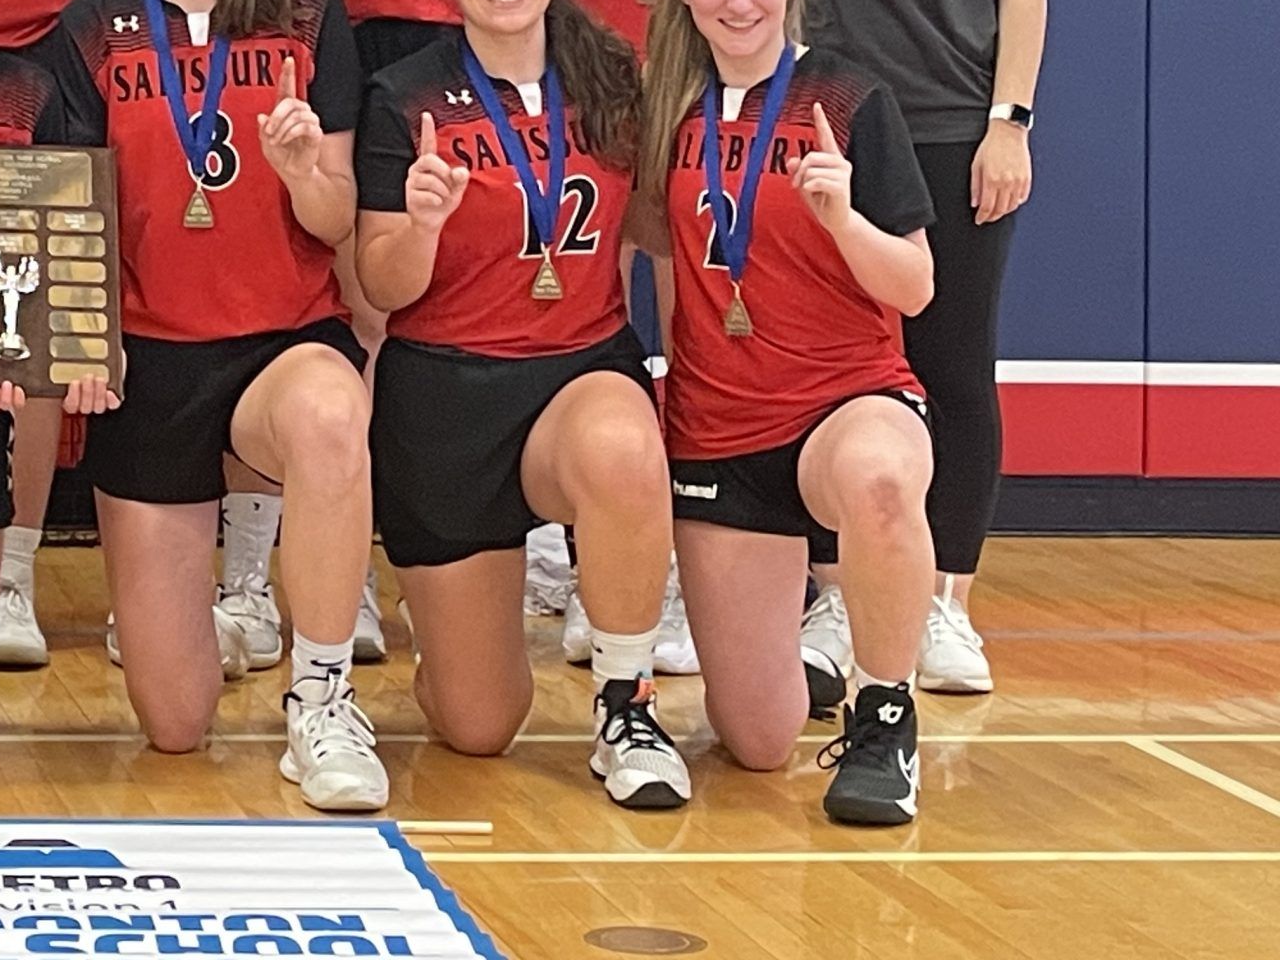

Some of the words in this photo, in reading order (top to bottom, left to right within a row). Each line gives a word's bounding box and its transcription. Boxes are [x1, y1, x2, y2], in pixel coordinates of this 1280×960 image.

[187, 109, 240, 191] 8
[514, 174, 600, 258] 12
[696, 188, 738, 270] 2
[25, 933, 413, 955] SCHOOL
